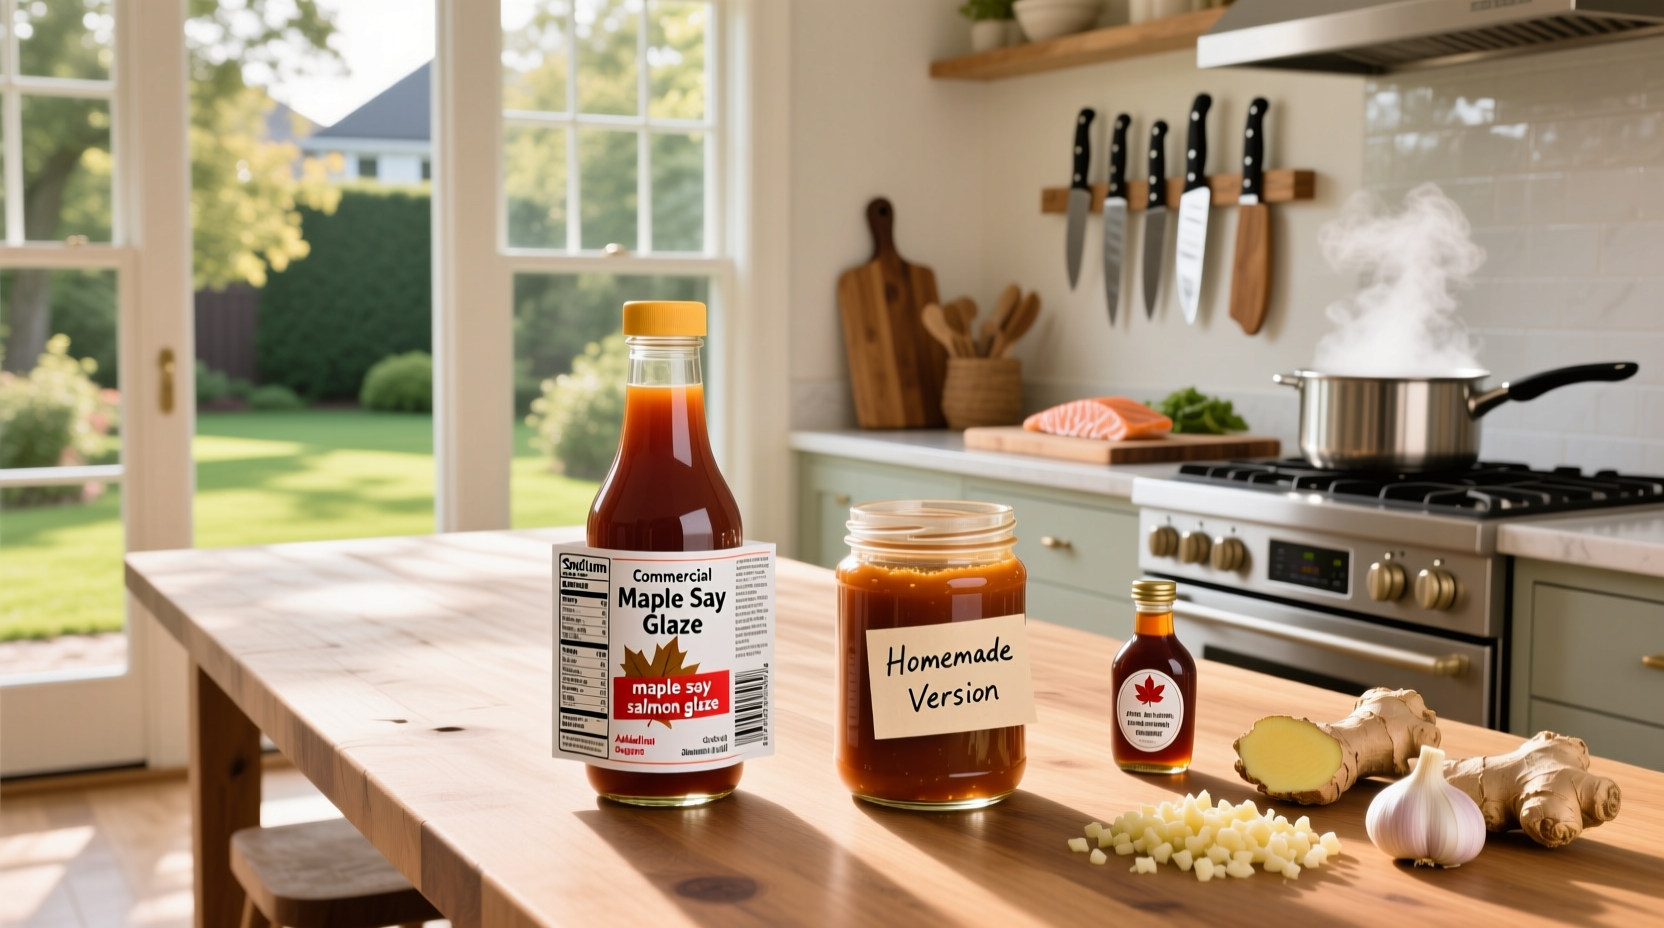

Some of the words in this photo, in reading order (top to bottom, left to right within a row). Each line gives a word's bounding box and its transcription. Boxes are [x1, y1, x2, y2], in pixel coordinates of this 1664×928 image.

[633, 567, 712, 583] Commercial
[618, 586, 684, 613] Maple
[690, 587, 727, 613] Say
[642, 614, 703, 635] Glaze
[886, 636, 1014, 677] Homemade
[632, 678, 681, 699] maple
[908, 681, 1000, 713] Version
[627, 698, 680, 714] salmon
